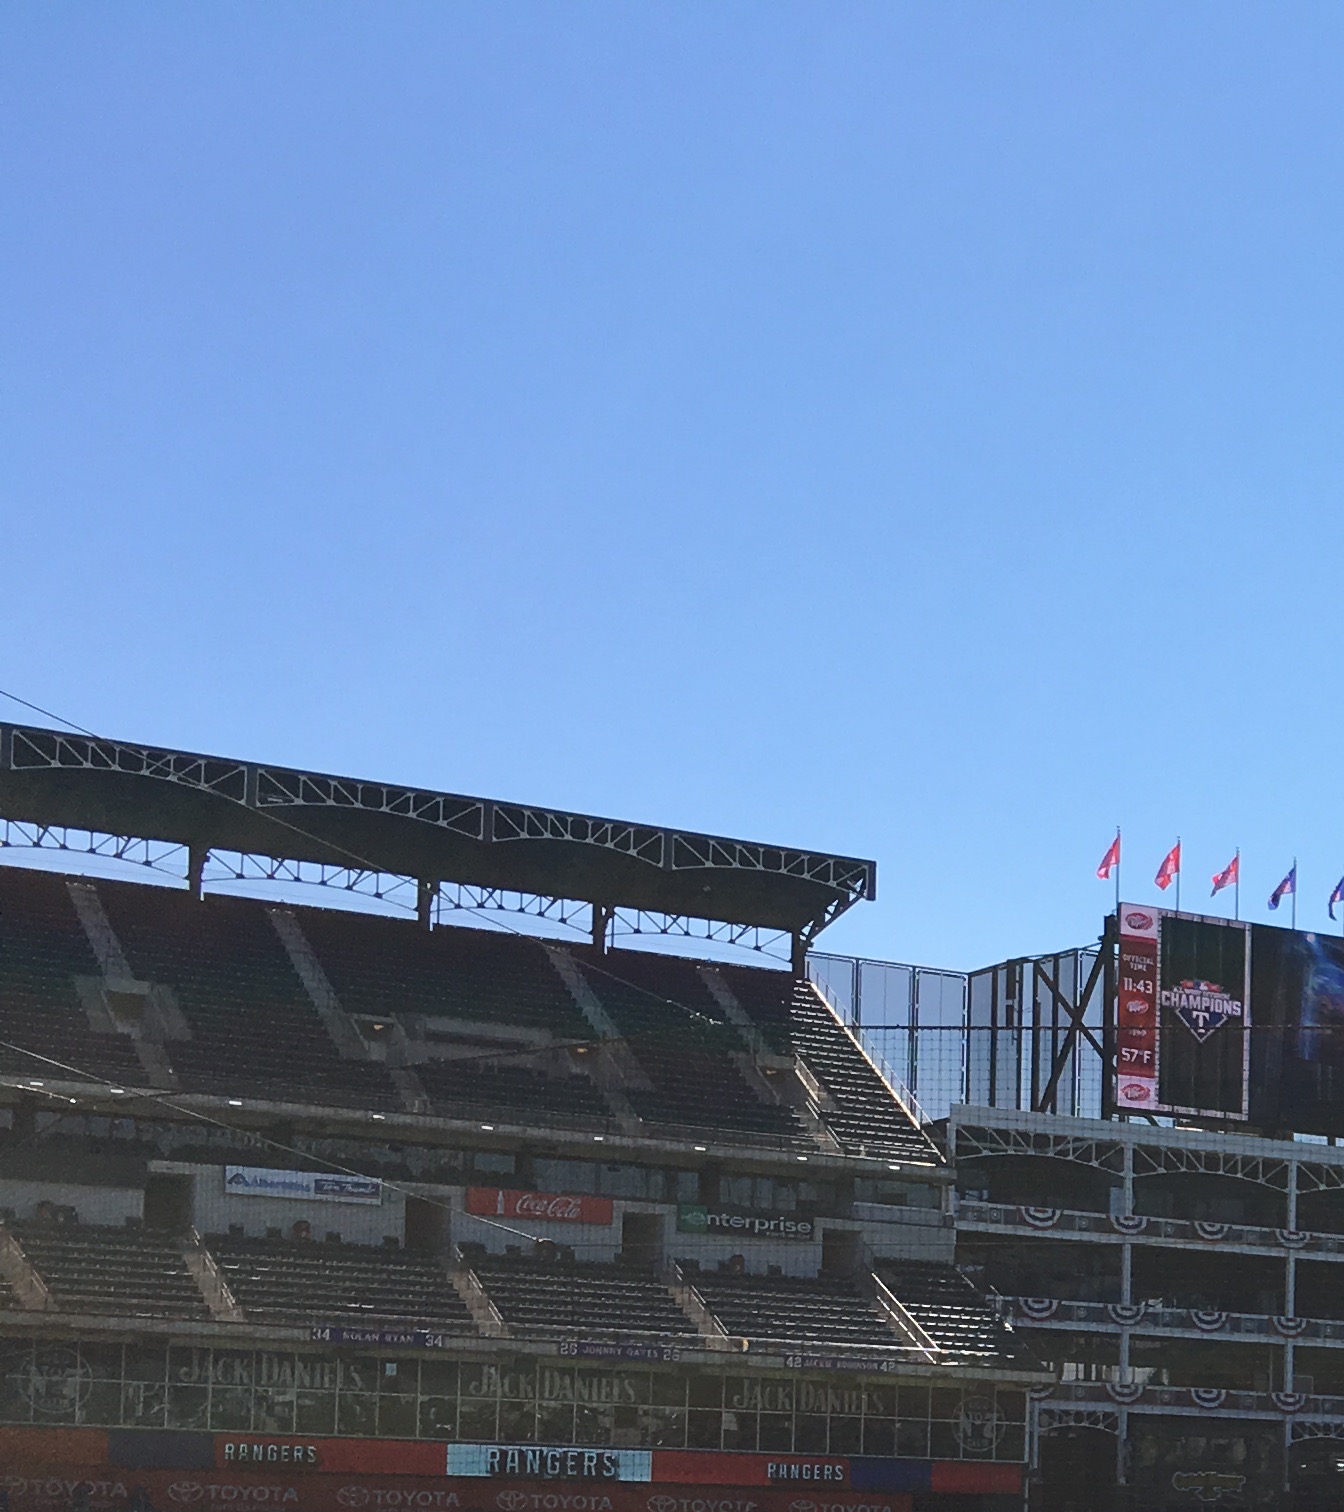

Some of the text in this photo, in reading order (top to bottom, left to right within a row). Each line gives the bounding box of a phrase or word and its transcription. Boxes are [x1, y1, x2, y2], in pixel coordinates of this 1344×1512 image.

[1123, 977, 1154, 994] 11:43
[1161, 989, 1242, 1017] CHAMPIONS
[1192, 1010, 1210, 1034] T
[515, 1193, 582, 1219] Coca-Cola
[688, 1208, 813, 1235] enterprise
[312, 1327, 331, 1341] 34
[424, 1334, 443, 1348] 34
[560, 1342, 578, 1356] 26
[663, 1349, 680, 1361] 26
[179, 1353, 251, 1386] JACK
[786, 1354, 802, 1368] 42
[879, 1361, 896, 1373] 42
[469, 1365, 534, 1398] JACK
[733, 1379, 791, 1413] JACK
[224, 1443, 317, 1463] RANGERS
[488, 1450, 616, 1477] RANGERS
[767, 1462, 845, 1482] RANGERS
[27, 1480, 128, 1499] TOYOTA
[207, 1483, 300, 1502] TOYOTA
[372, 1490, 461, 1508] TOYOTA
[530, 1494, 614, 1511] TOYOTA
